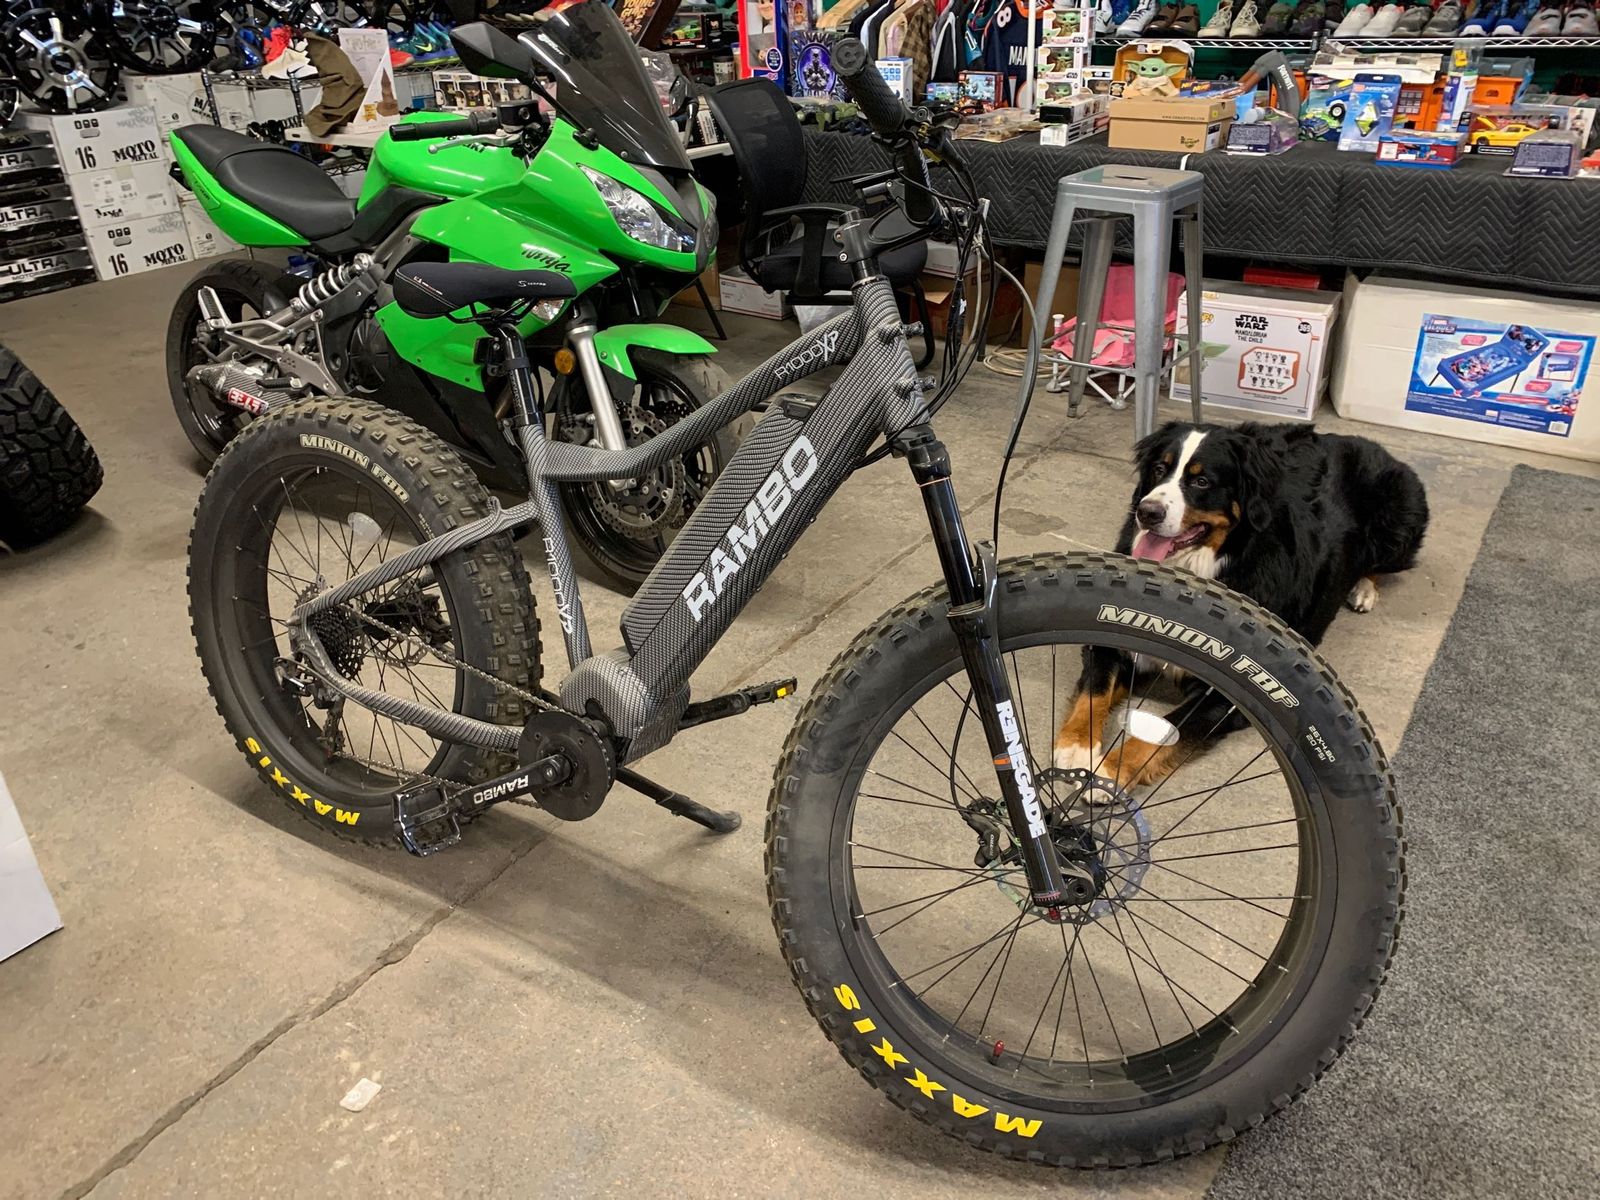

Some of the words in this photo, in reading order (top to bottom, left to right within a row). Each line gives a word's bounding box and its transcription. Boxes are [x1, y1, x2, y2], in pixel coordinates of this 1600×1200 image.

[75, 146, 96, 170] 16
[112, 140, 155, 162] MOTO
[9, 255, 69, 276] ULTRA
[108, 253, 129, 276] 16
[143, 243, 184, 267] MOTO
[1235, 314, 1269, 324] STAR
[1235, 321, 1269, 331] WARS
[300, 434, 370, 469] MINION
[682, 435, 818, 622] RAMBO
[1096, 604, 1235, 661] MINION
[1231, 654, 1300, 708] FBF
[244, 737, 361, 826] MAXXIS
[996, 699, 1047, 839] RENEGADE
[473, 774, 529, 805] RAMBO
[833, 983, 1043, 1138] MAXXIS
